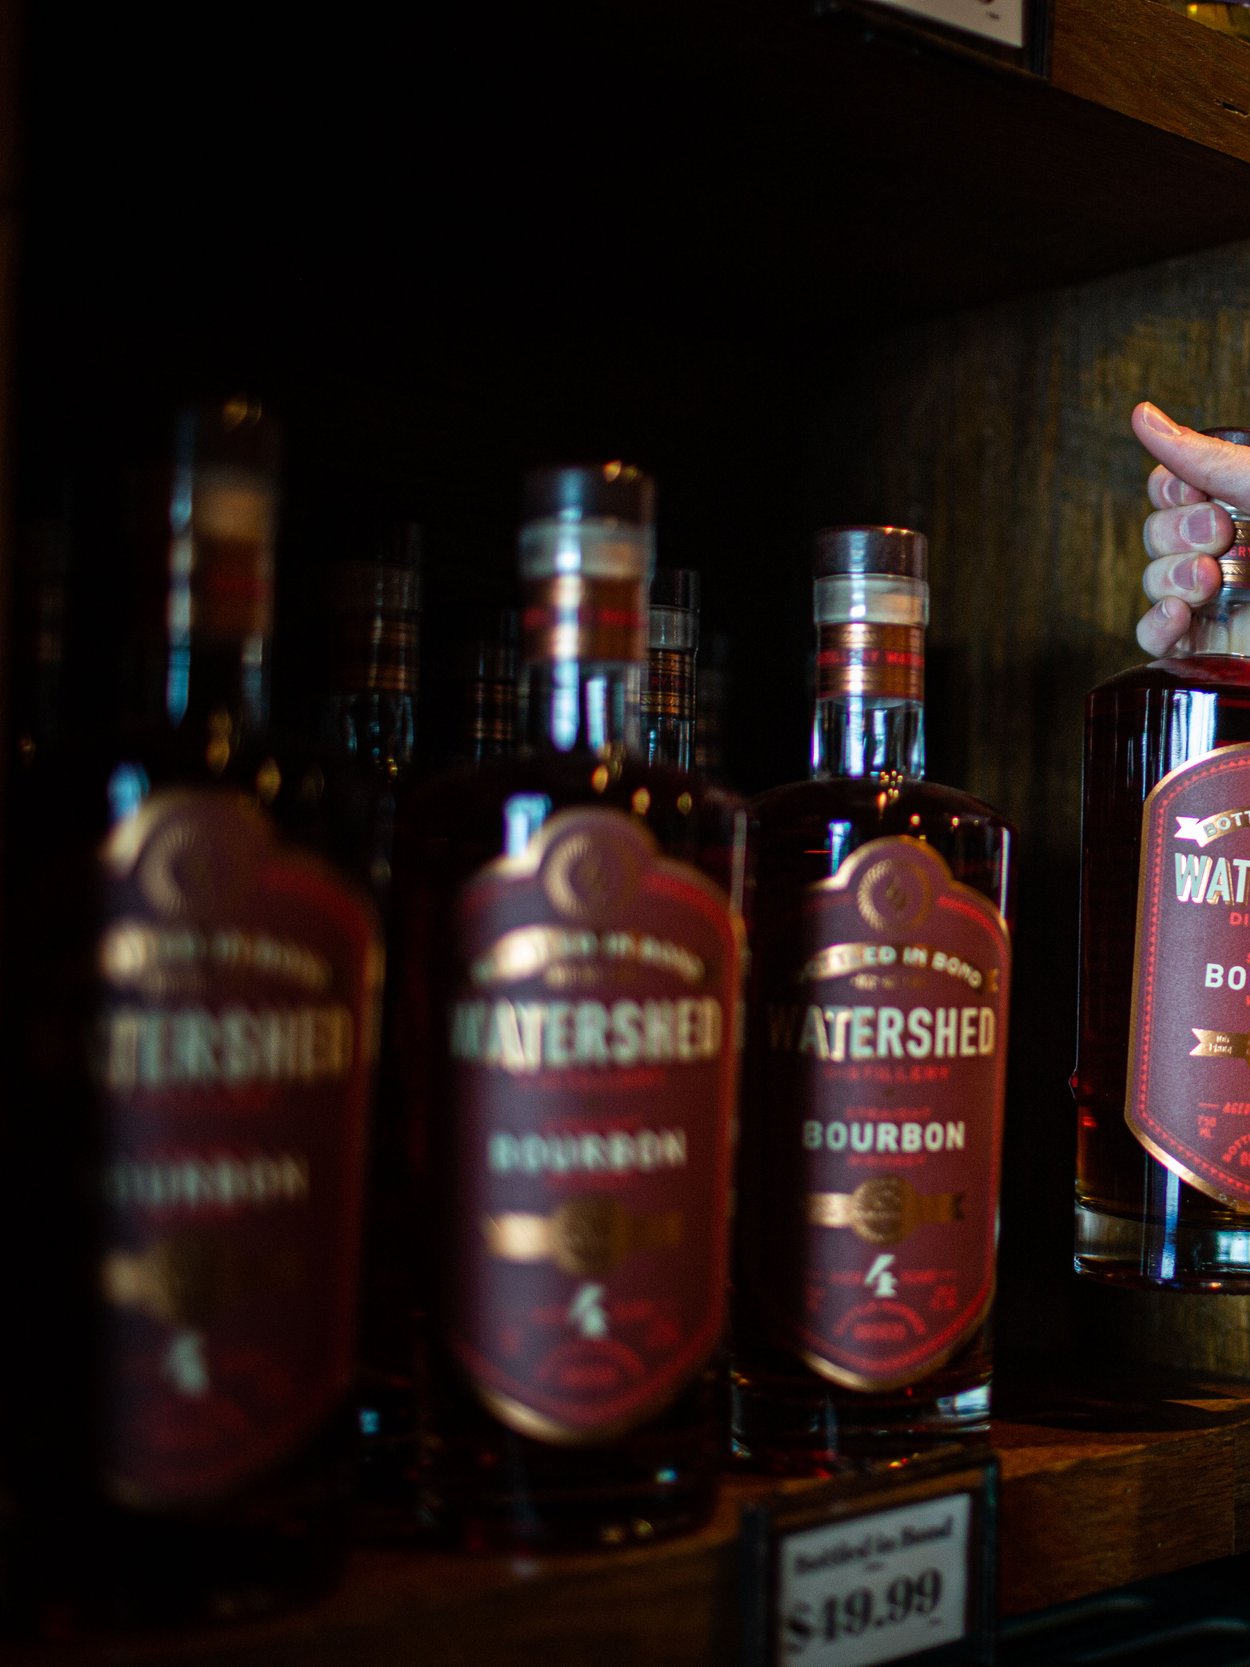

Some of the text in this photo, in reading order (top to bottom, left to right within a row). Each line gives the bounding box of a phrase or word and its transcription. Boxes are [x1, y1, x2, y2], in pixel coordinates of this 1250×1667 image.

[768, 1002, 997, 1063] WATERSHED
[802, 1118, 966, 1154] BOURBON
[863, 1252, 898, 1298] 4
